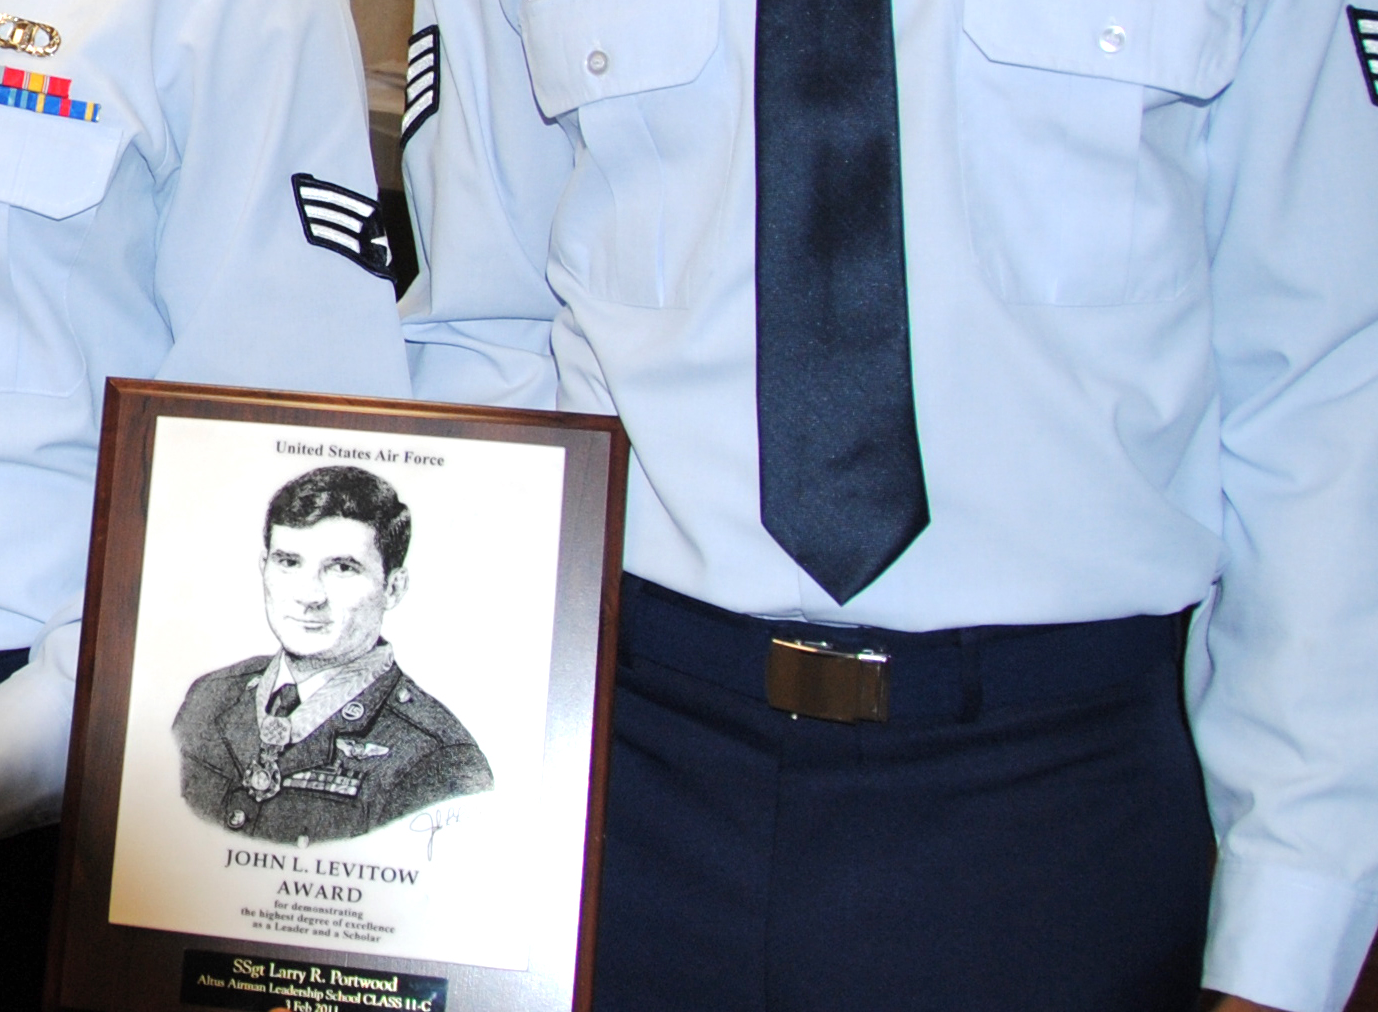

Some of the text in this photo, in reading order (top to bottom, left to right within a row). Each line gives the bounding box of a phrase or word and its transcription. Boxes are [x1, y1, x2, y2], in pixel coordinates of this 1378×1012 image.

[276, 441, 445, 467] United States Air Force
[225, 849, 420, 886] JOHN L. LEVITOW
[276, 880, 363, 904] AWARD
[241, 907, 396, 934] the highest degree of excellence
[274, 900, 364, 920] for demonstrating
[252, 920, 264, 929] as
[274, 922, 309, 935] Leader
[312, 927, 332, 938] and
[333, 931, 340, 939] a
[342, 930, 382, 943] Scholar
[232, 958, 398, 992] SSgt Larry R. Portwood
[197, 974, 433, 1012] Altus Airman Leadership School CLASS 11-C
[294, 1000, 313, 1012] Feb
